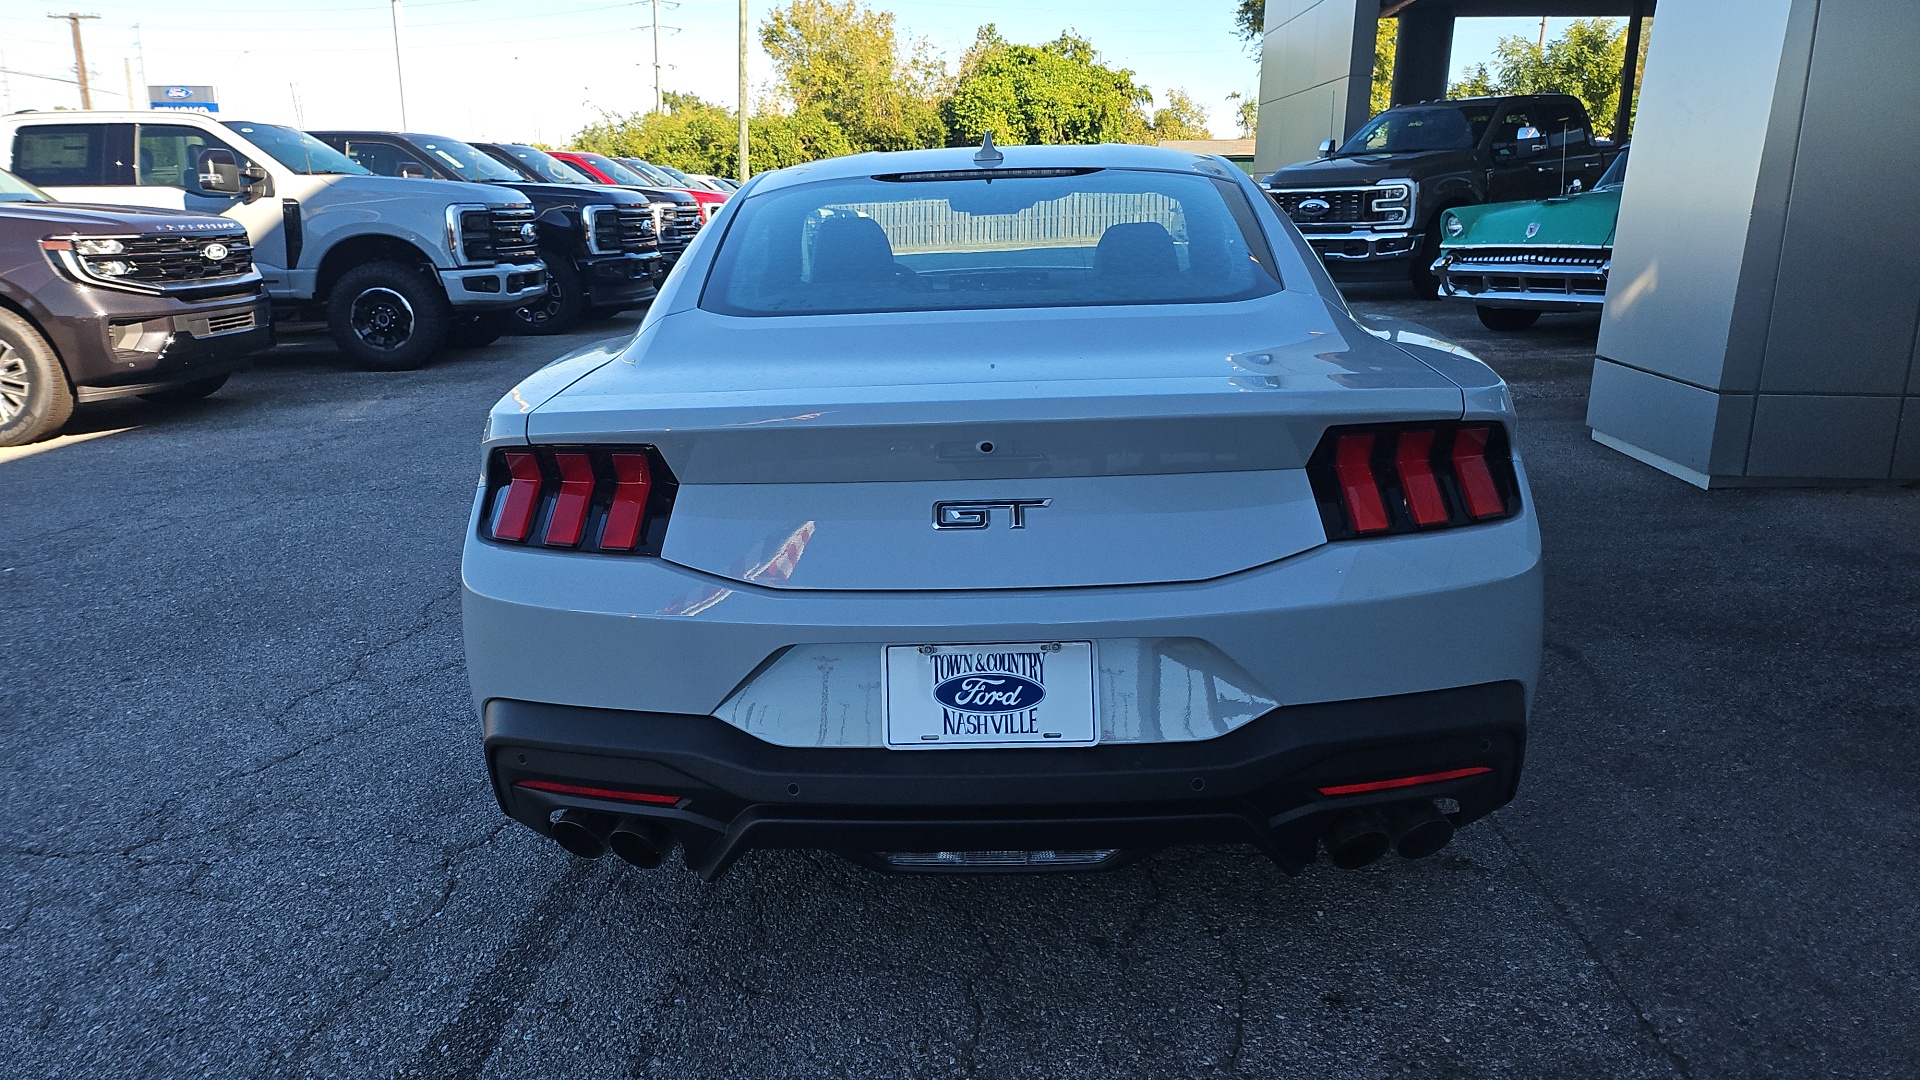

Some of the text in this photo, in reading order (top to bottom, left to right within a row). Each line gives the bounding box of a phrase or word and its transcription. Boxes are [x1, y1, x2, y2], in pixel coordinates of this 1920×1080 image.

[932, 498, 1052, 530] GT
[930, 654, 972, 685] TOWN
[986, 652, 1046, 685] COUNTRY
[955, 678, 1022, 705] Ford
[942, 707, 1038, 734] NASHVILLE
